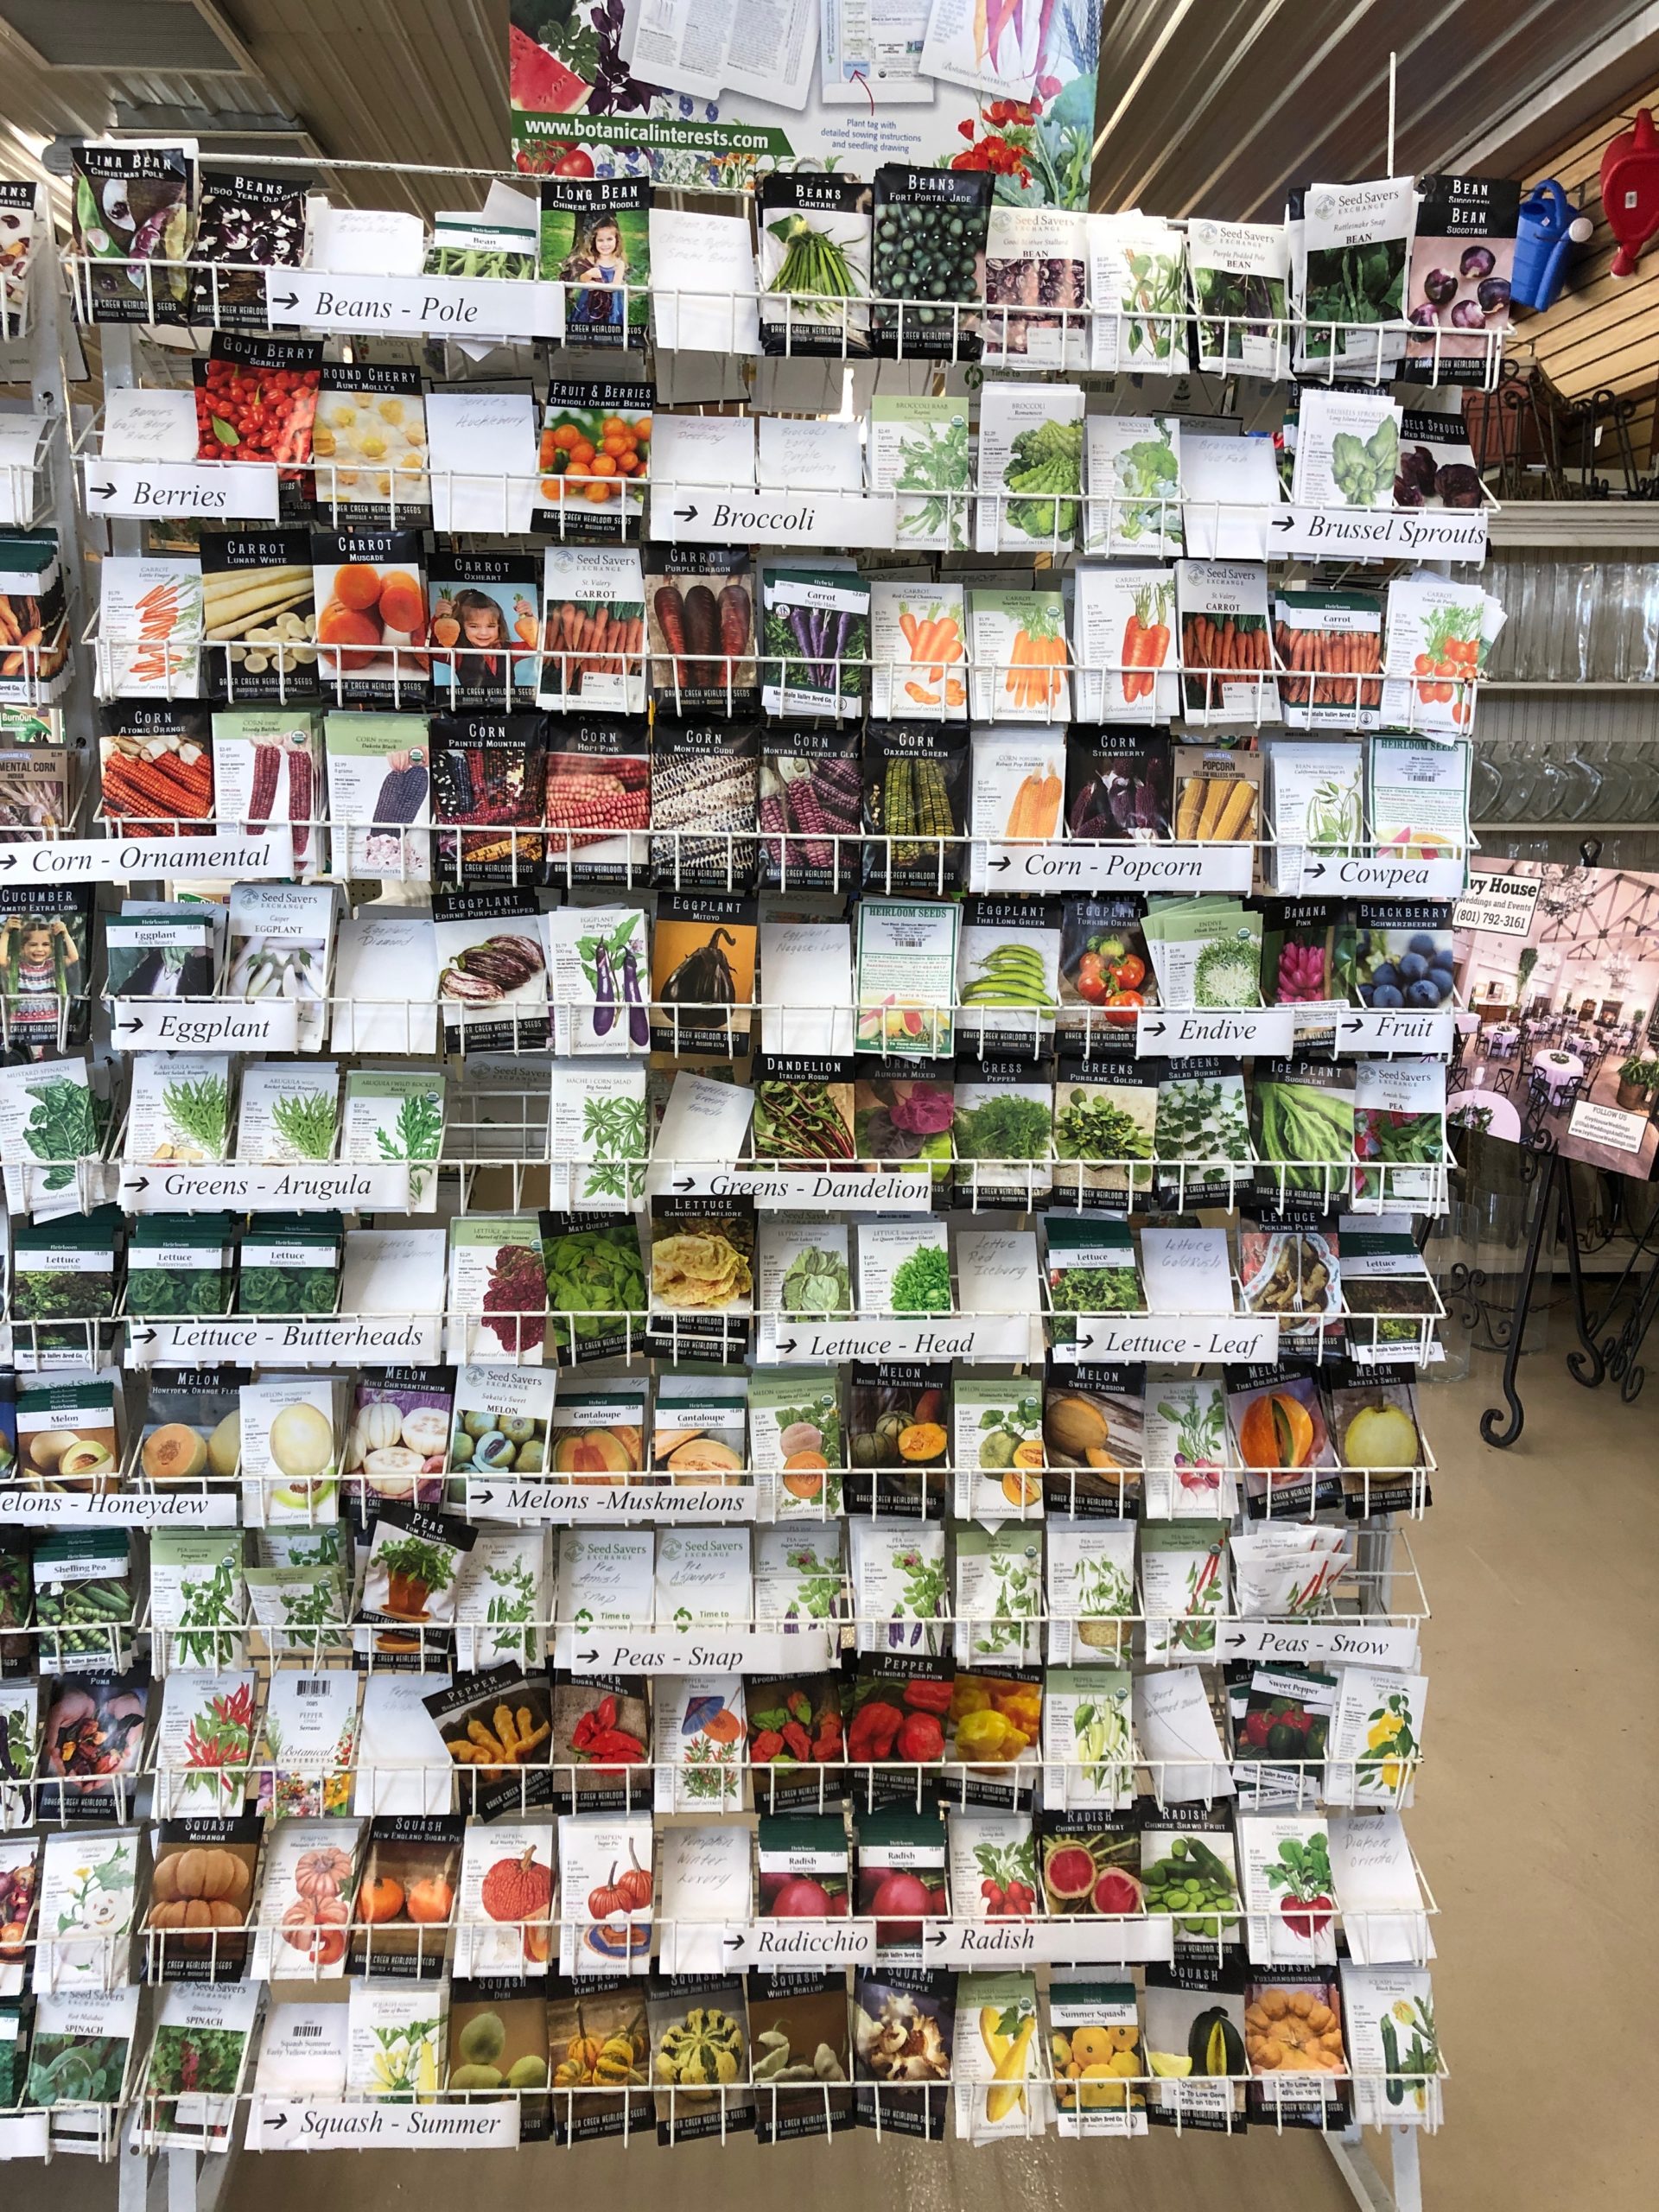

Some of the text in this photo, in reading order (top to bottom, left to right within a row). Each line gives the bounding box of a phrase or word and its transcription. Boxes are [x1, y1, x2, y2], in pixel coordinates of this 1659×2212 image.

[526, 119, 768, 149] www.botanicalinterests.com
[868, 122, 878, 130] tag
[880, 121, 896, 130] with
[821, 129, 921, 142] detailed sowing instructions
[848, 142, 878, 152] seedling
[880, 143, 909, 154] drawing
[1338, 189, 1399, 207] Seed Savers
[474, 237, 496, 246] Bean
[1220, 228, 1274, 244] Seed Savers
[1345, 233, 1372, 245] BEAN
[315, 292, 479, 322] Beans Pole
[133, 482, 226, 507] Berries
[712, 505, 816, 531] Broccoli
[1308, 515, 1485, 548] Brussel Sprouts
[577, 556, 635, 566] Seed Savers
[1207, 568, 1255, 581] Seed Savers
[808, 591, 836, 602] Carrot
[1324, 614, 1351, 624] Carrot
[33, 844, 270, 873] Corn Ornamental
[1025, 854, 1202, 881] Corn Popcorn
[1339, 861, 1428, 889] Cowpea
[1470, 877, 1537, 897] vy House
[1460, 896, 1491, 907] Weddings
[1507, 901, 1531, 912] Events
[1457, 909, 1525, 929] (801) 792-3161
[135, 931, 176, 941] Eggplant
[158, 1015, 270, 1044] Eggplant
[1179, 1020, 1256, 1040] Endive
[1376, 1017, 1433, 1037] Fruit
[1593, 1106, 1618, 1118] FOLLOW
[165, 1173, 371, 1198] Greens Arugula
[709, 1175, 930, 1200] Greens Dandelion
[46, 1255, 80, 1264] Lettuce
[158, 1253, 192, 1262] Lettuce
[270, 1251, 304, 1260] Lettuce
[172, 1324, 423, 1347] Lettuce Butterheads
[810, 1332, 975, 1356] Lettuce Head
[1105, 1332, 1262, 1359] Lettuce Leaf
[51, 1414, 79, 1423] Melon
[574, 1409, 621, 1421] Cantaloupe
[677, 1413, 725, 1423] Cantaloupe
[87, 1495, 207, 1519] Honeydew
[506, 1489, 588, 1510] Melons
[54, 1563, 106, 1575] Shelling Pea
[1258, 1631, 1389, 1656] Peas Snow
[613, 1647, 665, 1668] Peas
[688, 1646, 743, 1671] Snap
[1268, 1678, 1319, 1696] Sweet Pepper
[280, 1745, 334, 1757] Botanical
[789, 1857, 817, 1866] Radish
[888, 1852, 915, 1860] Radish
[759, 1930, 868, 1953] Radicchio
[960, 1928, 1034, 1950] Radish
[1095, 2010, 1126, 2019] Squash
[300, 2110, 500, 2134] Squash Summer
